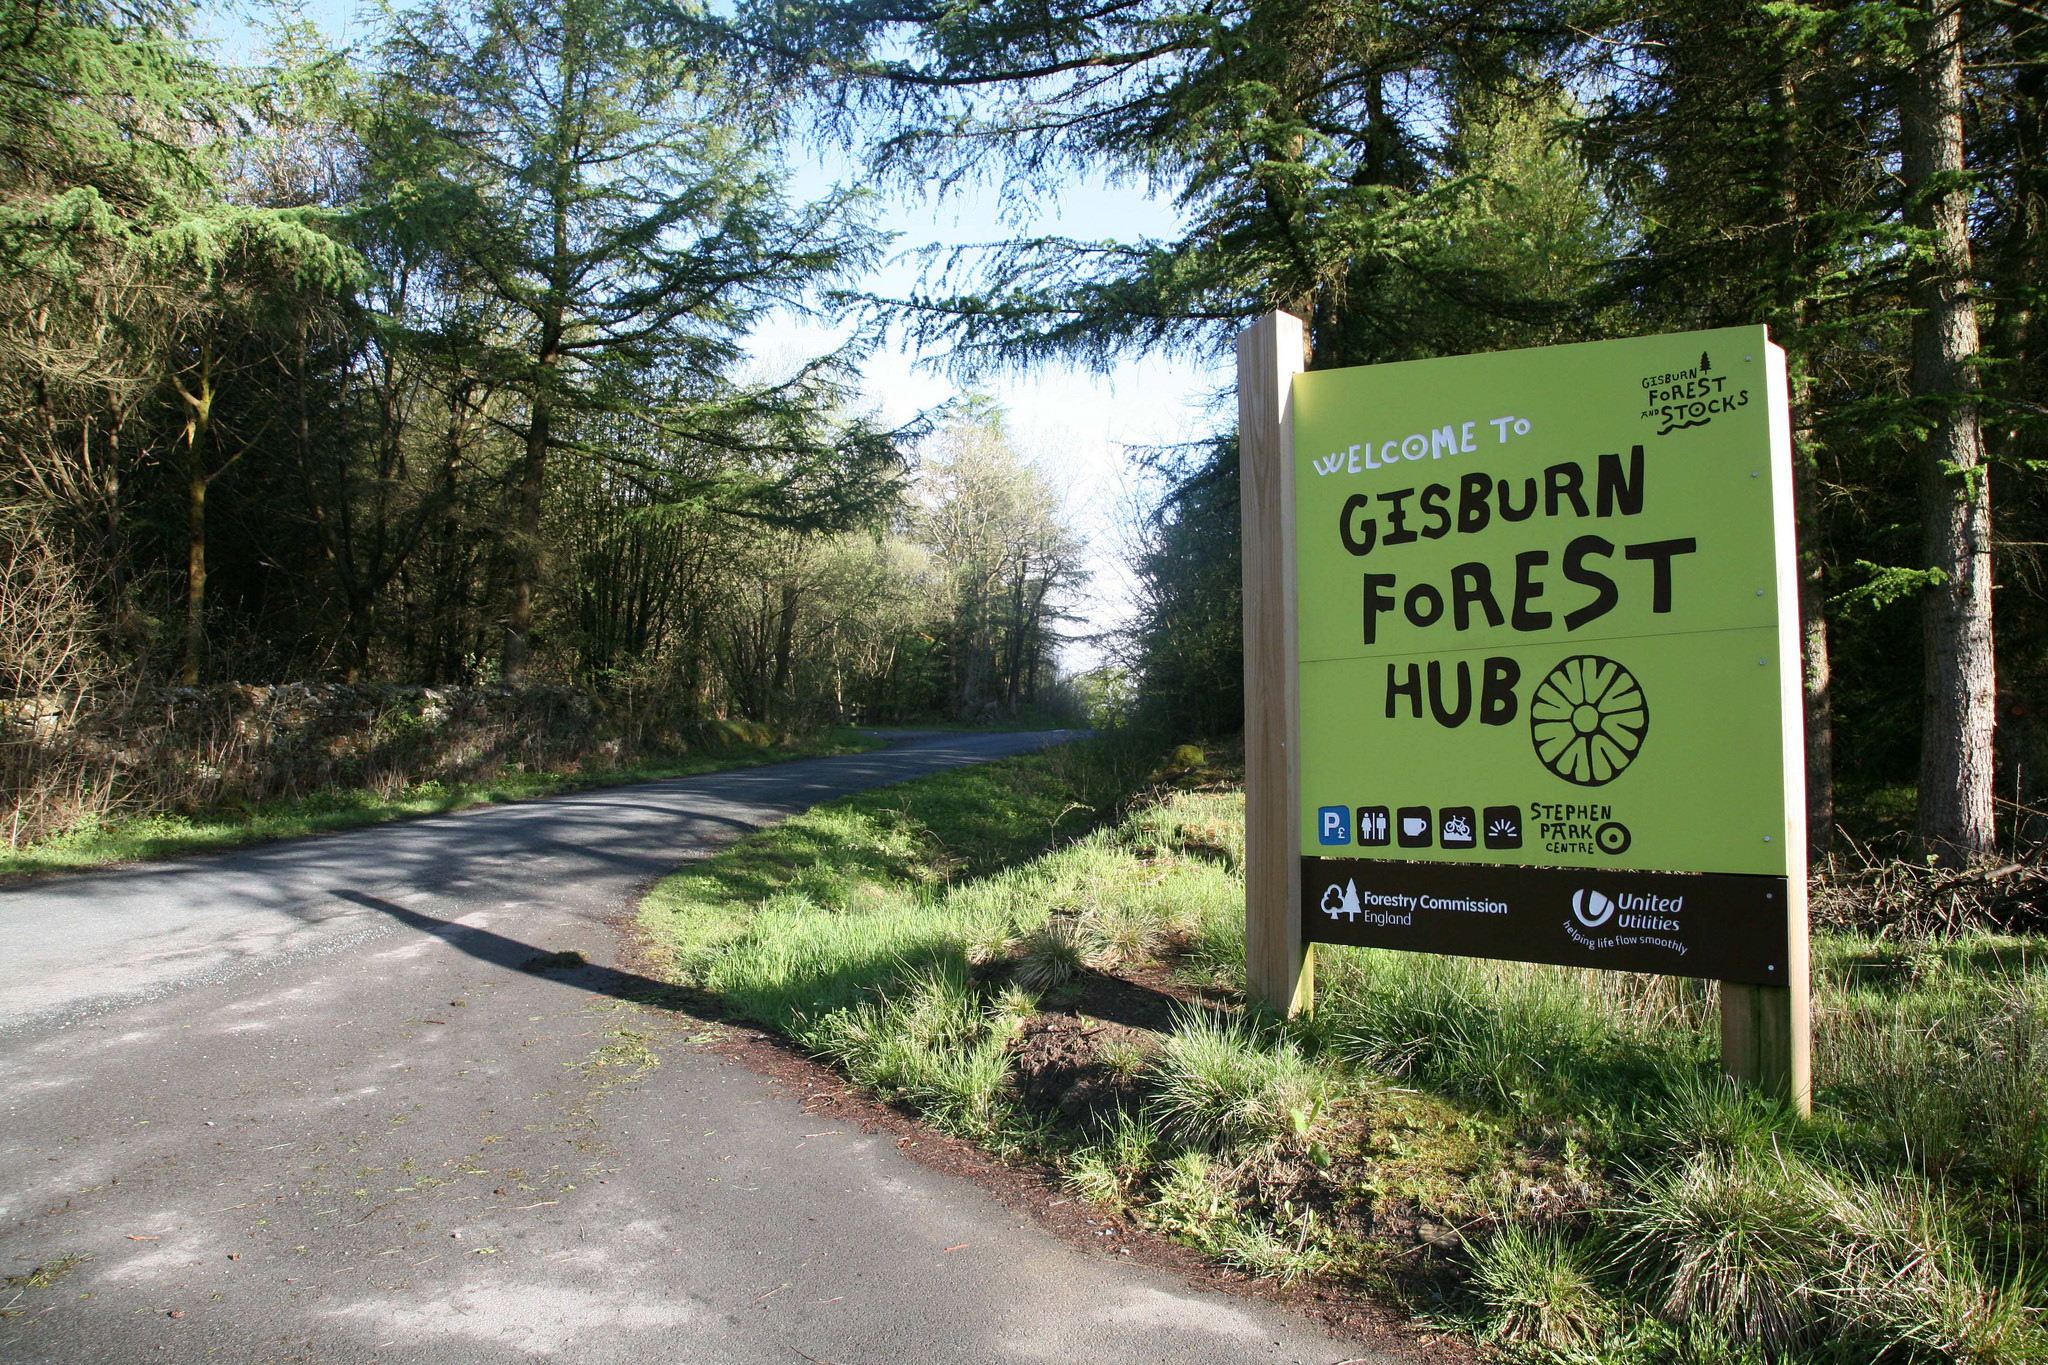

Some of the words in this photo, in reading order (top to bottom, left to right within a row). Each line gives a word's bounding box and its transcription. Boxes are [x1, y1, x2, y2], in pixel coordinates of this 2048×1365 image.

[1641, 367, 1697, 389] GISBURN
[1640, 408, 1660, 420] AND
[1660, 389, 1749, 426] STOCKS
[1312, 420, 1478, 476] WELCOME
[1339, 444, 1645, 557] GISBURN
[1384, 656, 1522, 729] HUB
[1530, 801, 1612, 821] STEPHEN
[1540, 822, 1593, 840] PARK
[1545, 841, 1595, 855] CENTRE
[1364, 891, 1417, 912] Forestry
[1420, 894, 1508, 915] Commission
[1618, 892, 1684, 913] United
[1364, 909, 1412, 927] England
[1618, 913, 1681, 932] Utilities
[1562, 919, 1596, 951] helping
[1597, 937, 1614, 949] life
[1615, 935, 1638, 946] flow
[1639, 936, 1688, 957] smoothly
